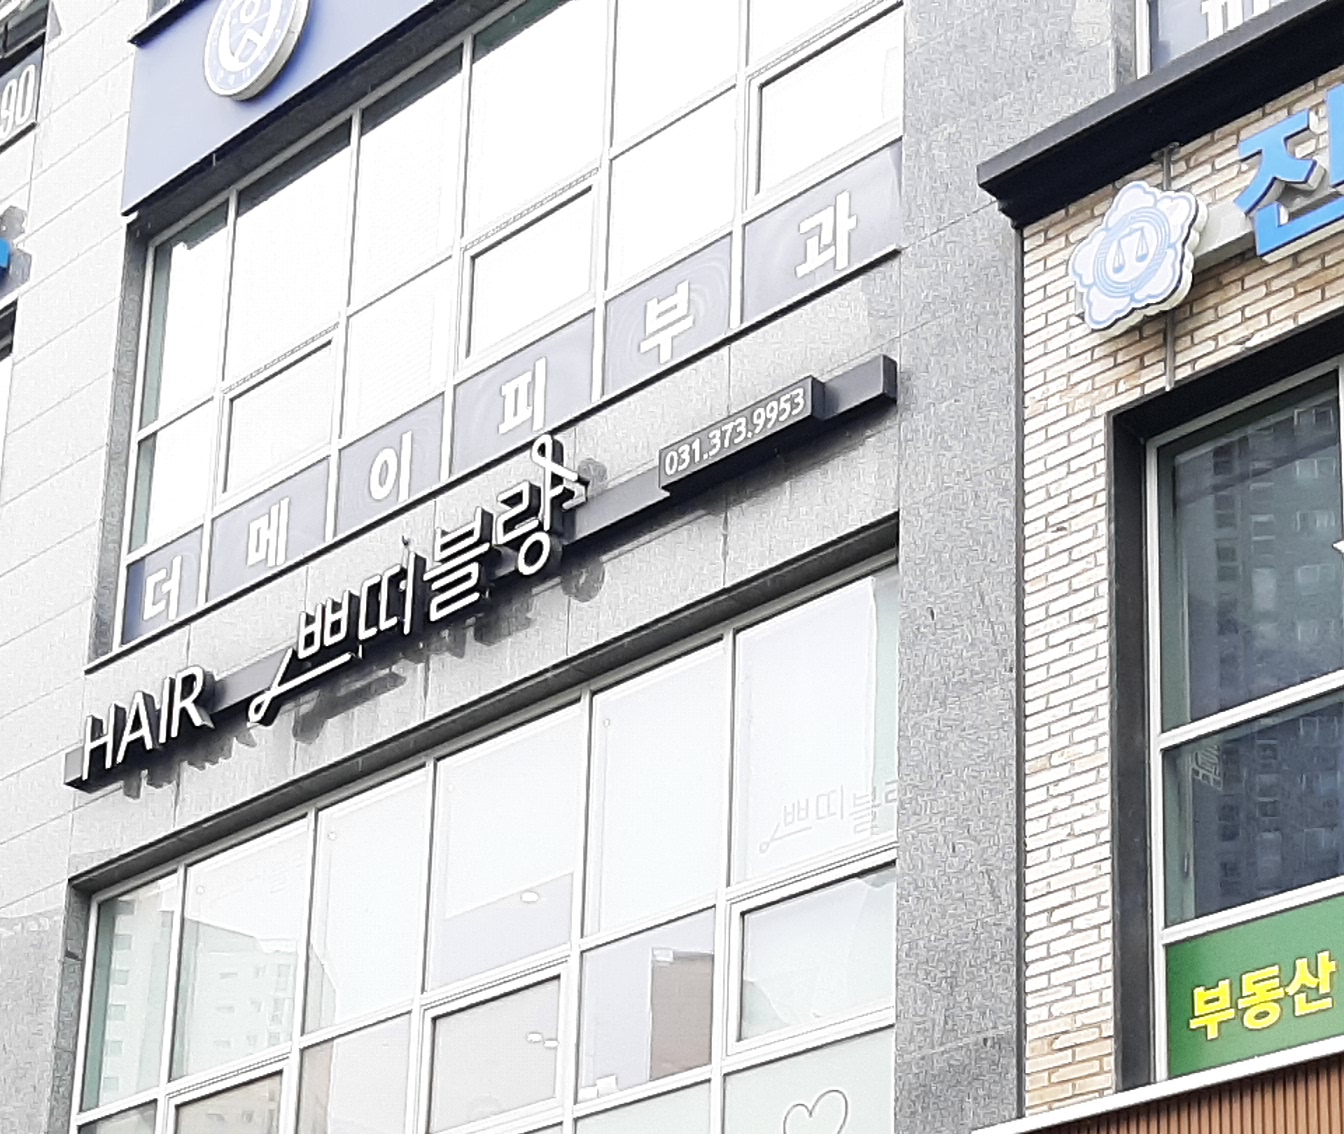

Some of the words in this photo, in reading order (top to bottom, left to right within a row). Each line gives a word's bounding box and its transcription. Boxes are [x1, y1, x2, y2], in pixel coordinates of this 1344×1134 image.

[663, 387, 807, 480] 031.373.9953
[80, 664, 216, 782] HAIR
[248, 434, 589, 729] 쁘띠블랑
[1186, 946, 1341, 1042] 부동산
